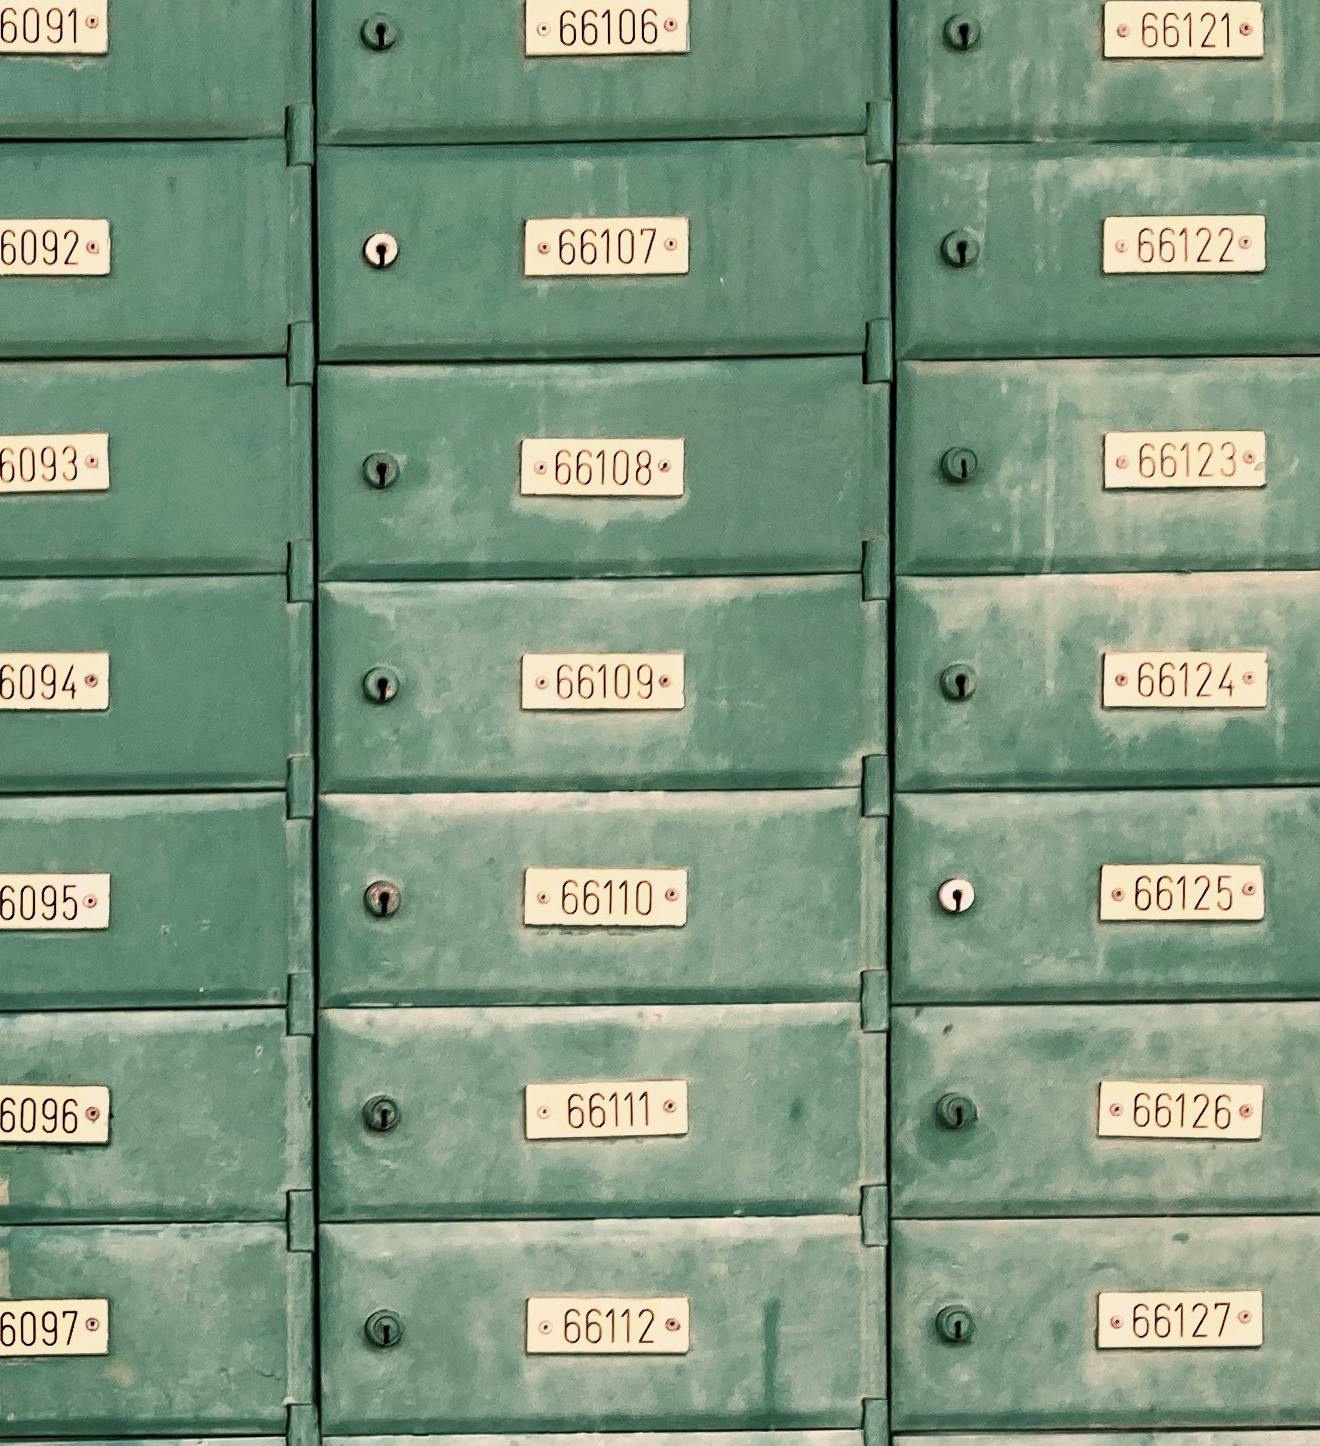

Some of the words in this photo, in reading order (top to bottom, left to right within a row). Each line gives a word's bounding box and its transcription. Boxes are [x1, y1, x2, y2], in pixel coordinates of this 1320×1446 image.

[559, 8, 658, 47] 66106
[1141, 12, 1230, 48] 66121
[558, 227, 657, 266] 66107
[1137, 227, 1234, 264] 66122
[554, 449, 652, 486] 66108
[1138, 441, 1237, 479] 66123
[556, 663, 653, 700] 66109
[1137, 661, 1233, 698] 66124
[561, 879, 653, 916] 66110
[1134, 875, 1233, 912] 66125
[567, 1091, 649, 1129] 66111
[1133, 1092, 1231, 1130] 66126
[563, 1307, 655, 1345] 66112
[1132, 1302, 1231, 1339] 66127
